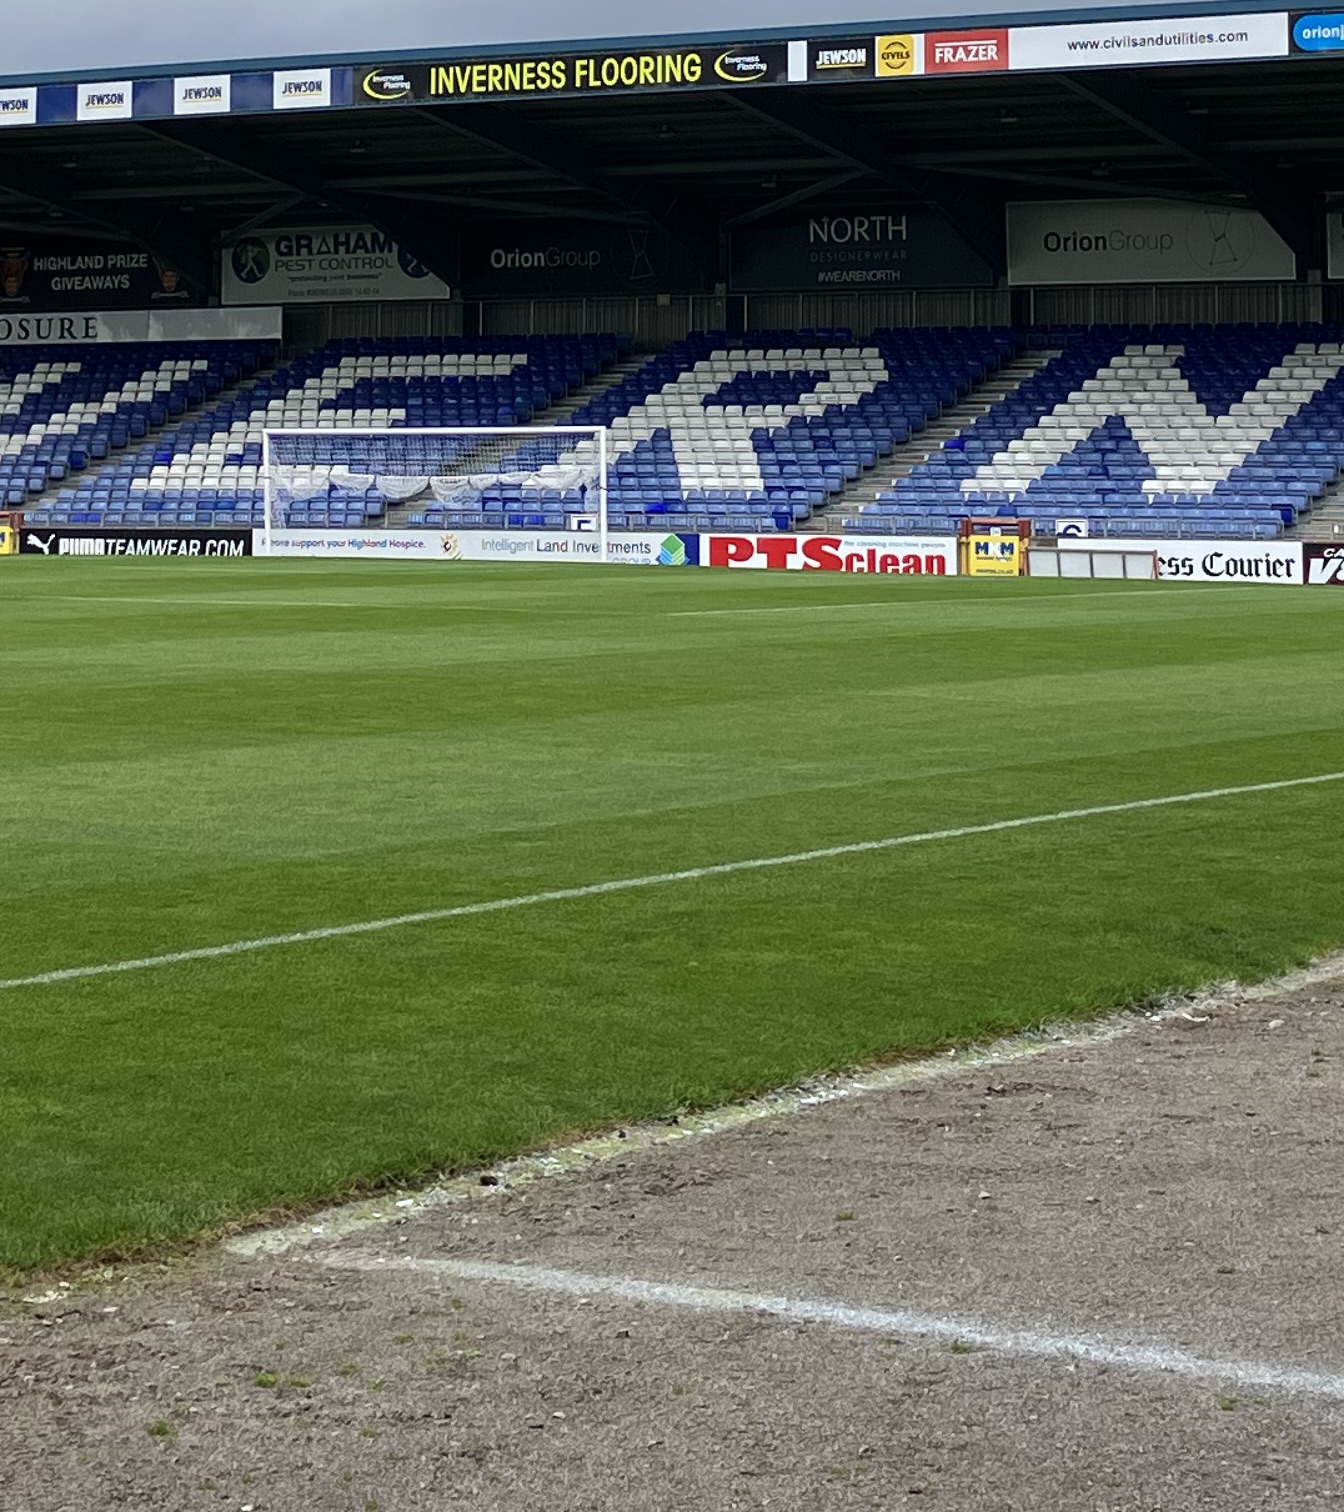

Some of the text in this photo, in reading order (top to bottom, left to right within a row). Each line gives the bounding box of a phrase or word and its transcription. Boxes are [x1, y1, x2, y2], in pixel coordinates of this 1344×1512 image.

[1067, 30, 1249, 51] www.civilsandutilities.com
[815, 48, 867, 66] JEWSON
[935, 44, 999, 64] FRAZER
[430, 53, 702, 94] INVERNESS FLOORING
[182, 86, 222, 100] JEWSON
[282, 80, 323, 93] JEWSON
[85, 92, 124, 106] JEWSON
[808, 215, 907, 244] NORTH
[275, 231, 393, 257] GRAHAM
[1044, 228, 1174, 254] OrionGroup
[32, 253, 149, 272] HIGHLAND PRIZE
[275, 256, 394, 273] PEST CONTROL
[490, 247, 601, 271] OrionGroup
[51, 274, 130, 292] GIVEAWAYS
[482, 538, 652, 555] Intelligent Land Invetments
[975, 541, 1014, 557] MKM
[1201, 551, 1296, 579] Courier
